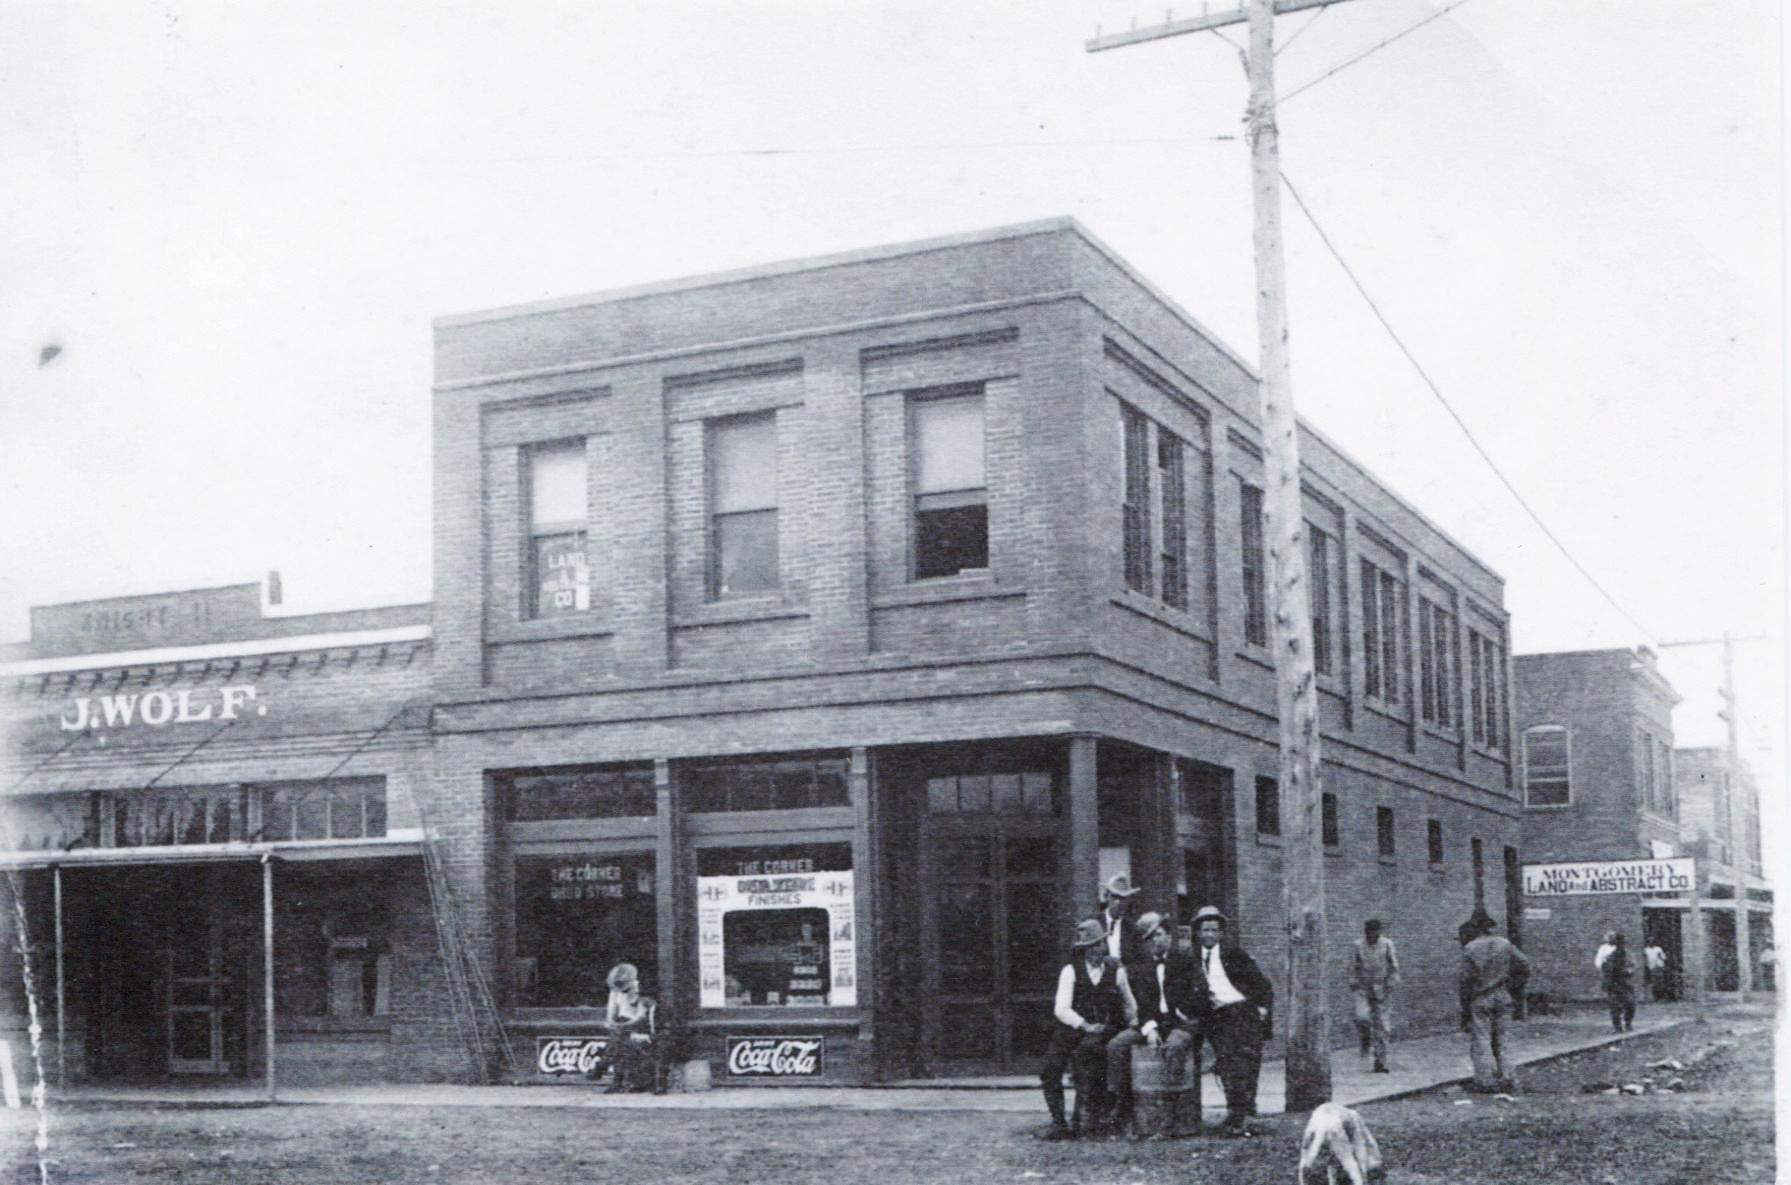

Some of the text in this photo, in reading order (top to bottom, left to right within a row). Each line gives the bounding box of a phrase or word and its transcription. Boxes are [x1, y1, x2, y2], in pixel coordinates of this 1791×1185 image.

[737, 858, 814, 875] THE CORNER
[1543, 864, 1676, 880] MONTGOMERY
[1527, 877, 1568, 894] LAND
[1590, 877, 1663, 892] ABSTRACT
[1669, 875, 1689, 889] CO
[748, 893, 802, 906] FINISHES
